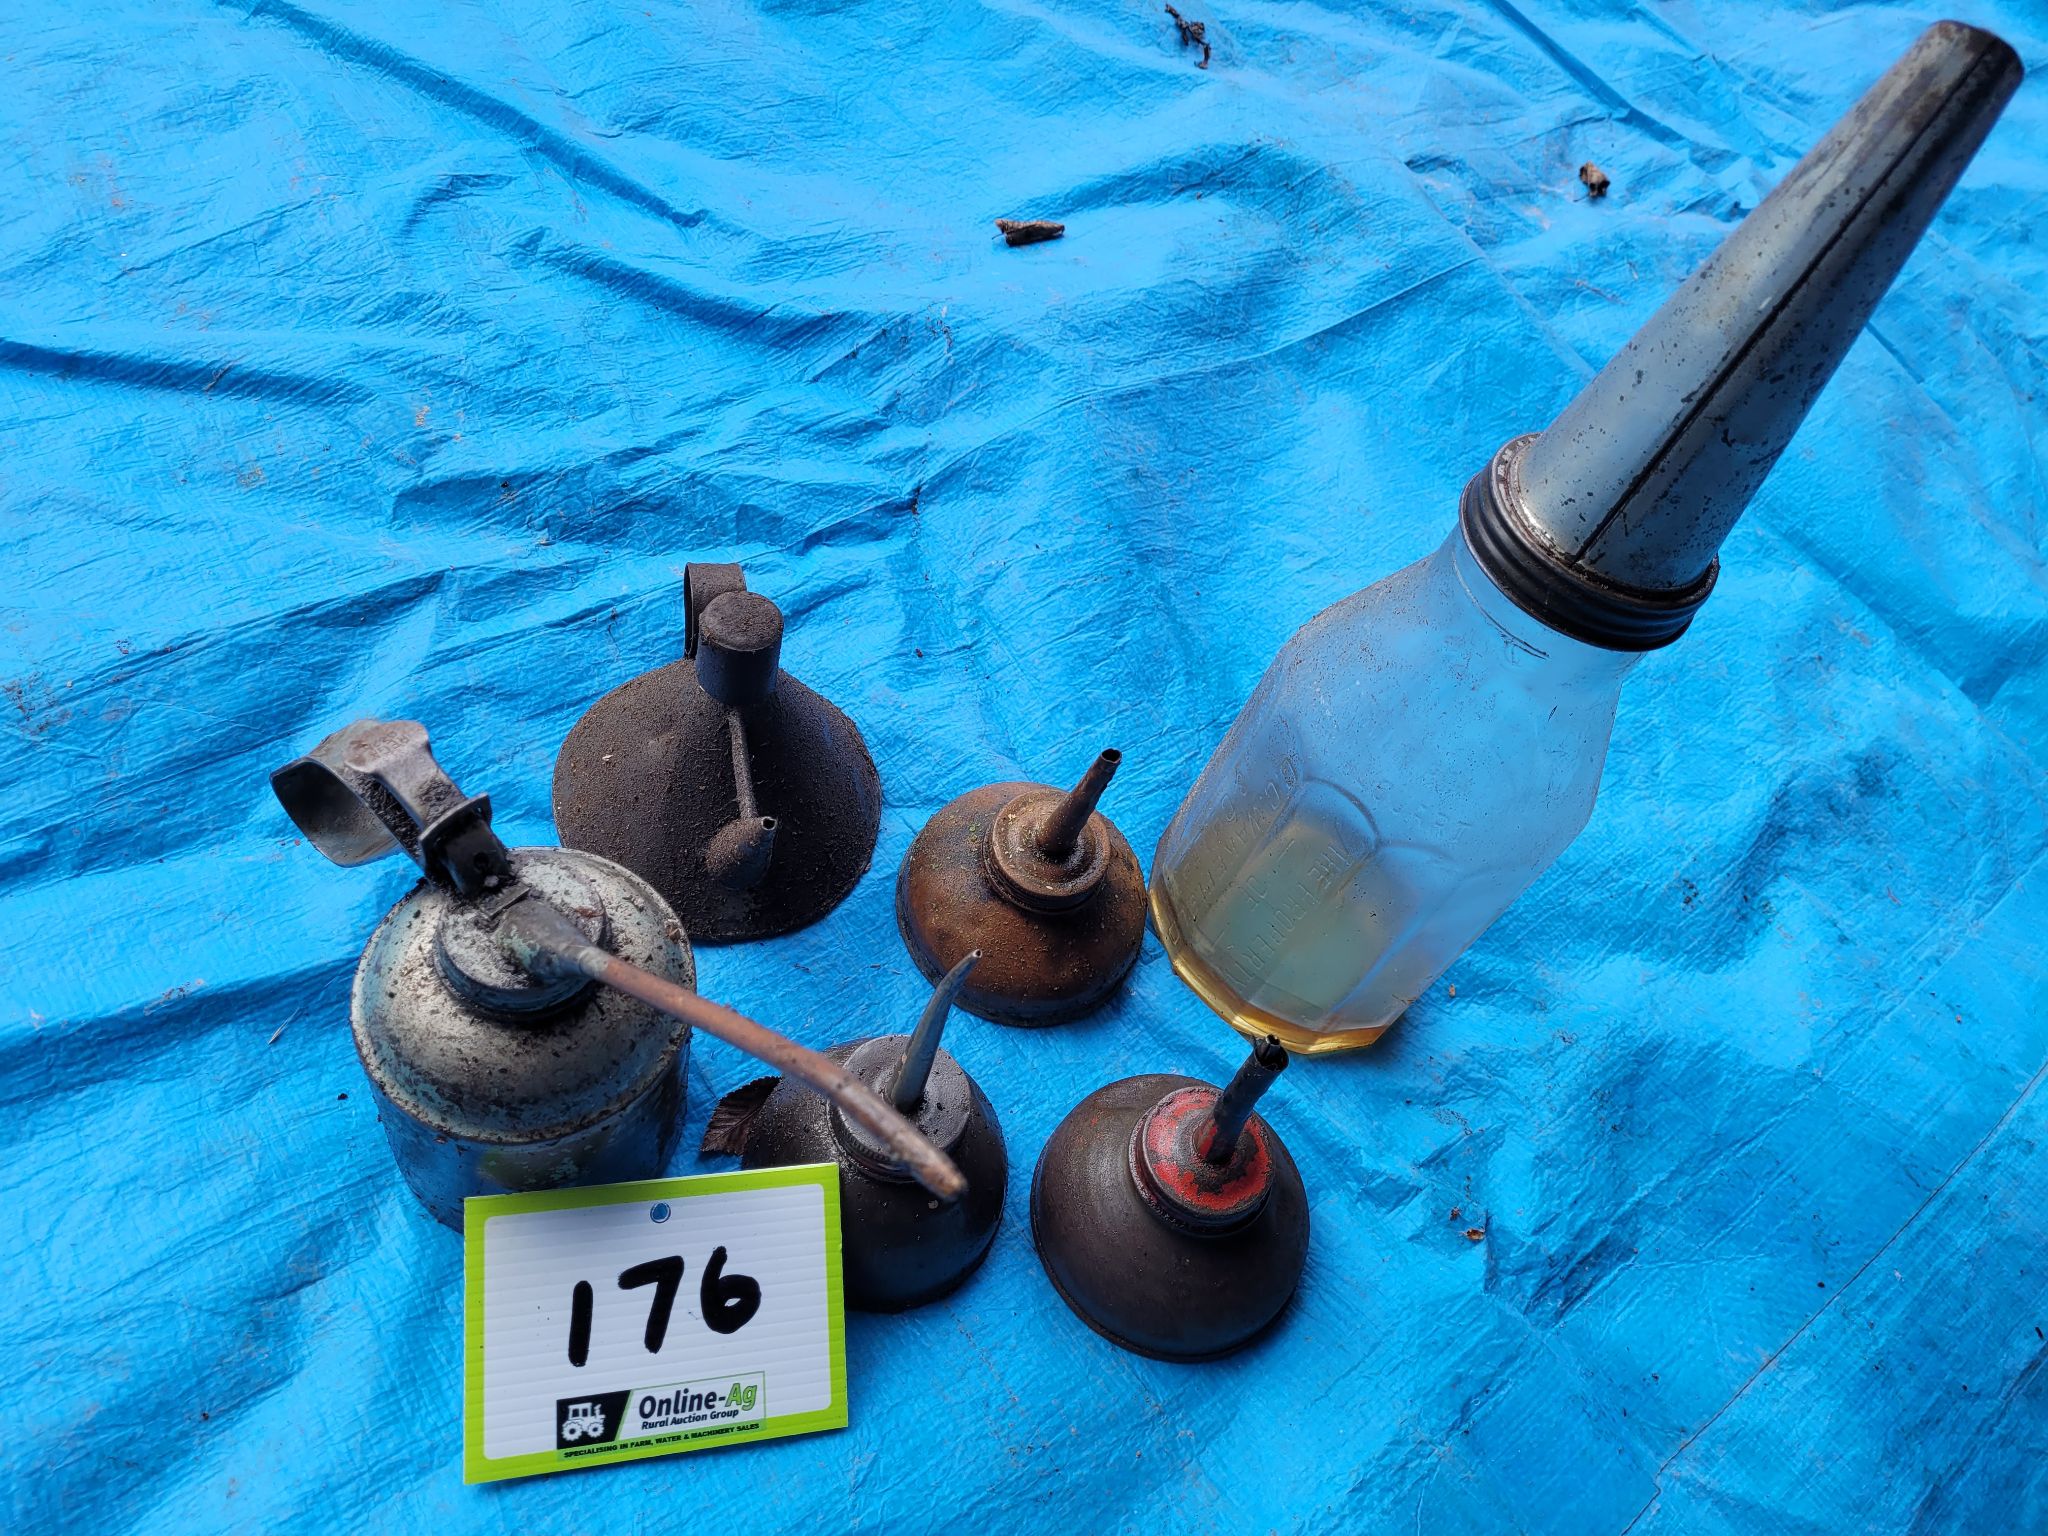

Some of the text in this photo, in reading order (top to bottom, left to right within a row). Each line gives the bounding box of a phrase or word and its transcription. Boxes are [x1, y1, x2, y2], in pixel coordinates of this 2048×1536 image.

[1223, 882, 1320, 991] PROPERTY
[568, 1246, 762, 1368] 176
[639, 1382, 758, 1419] Online-Ag
[641, 1409, 739, 1430] Rural Auction Group
[564, 1444, 618, 1458] SPECIALISING
[619, 1442, 629, 1450] IN
[655, 1434, 682, 1444] WATER
[690, 1426, 735, 1439] MACHINERY
[736, 1422, 760, 1432] SALES
